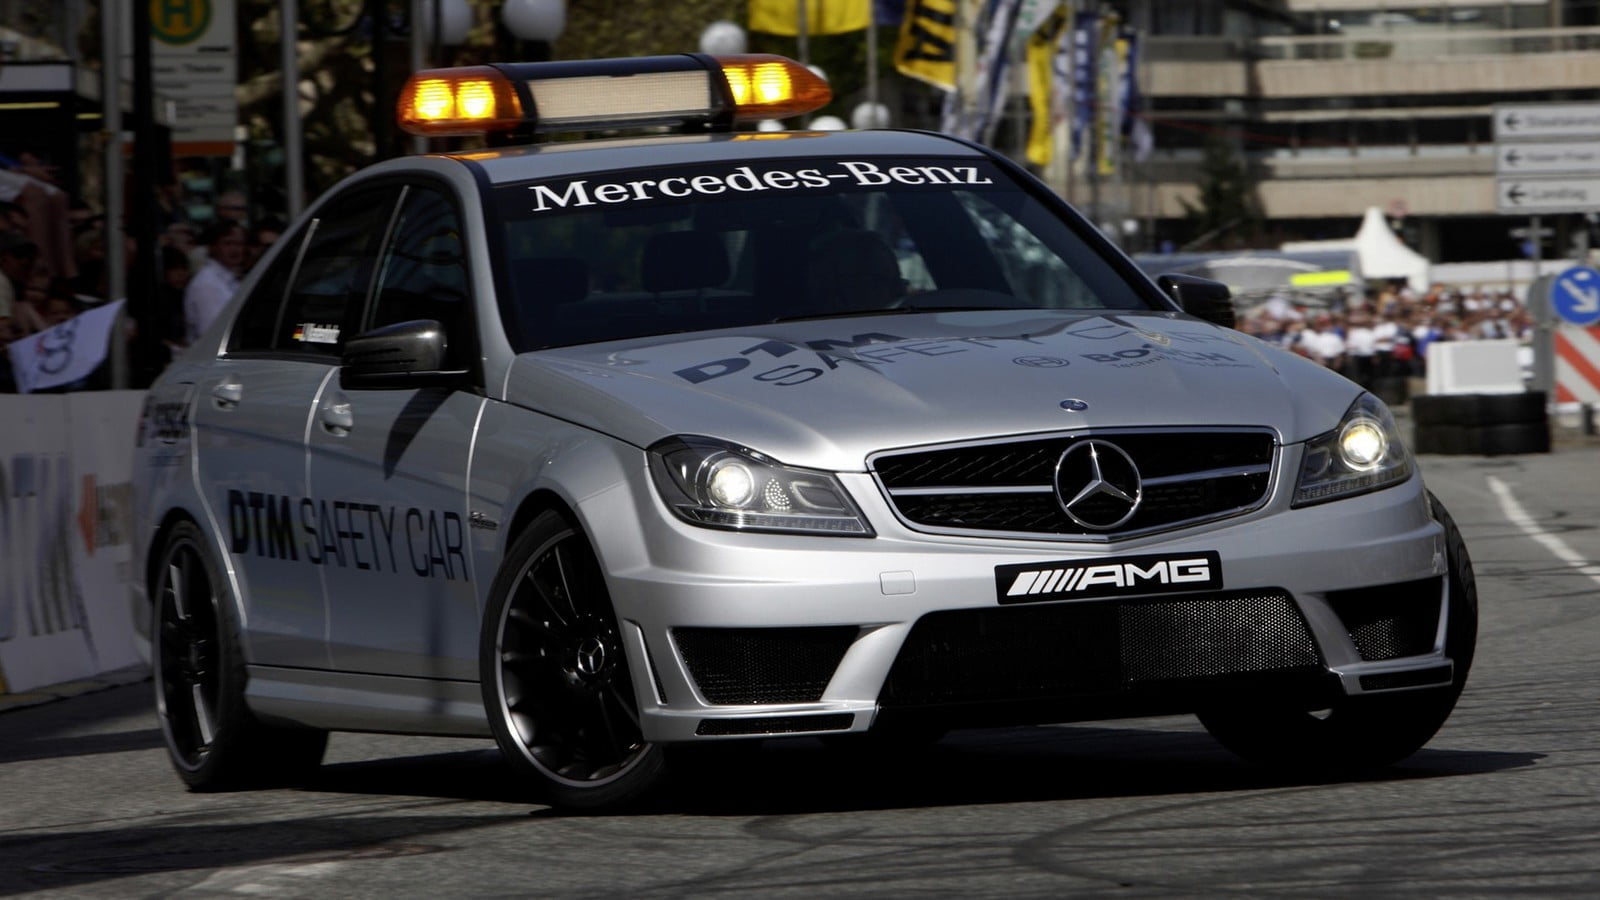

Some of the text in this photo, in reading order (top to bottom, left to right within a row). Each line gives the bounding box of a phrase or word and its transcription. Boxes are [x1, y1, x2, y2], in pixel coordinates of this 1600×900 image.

[529, 161, 993, 212] Mercedes-Benz
[673, 332, 905, 385] DTM
[228, 489, 469, 582] DTM SAFETY CAR
[1075, 557, 1211, 591] AMG
